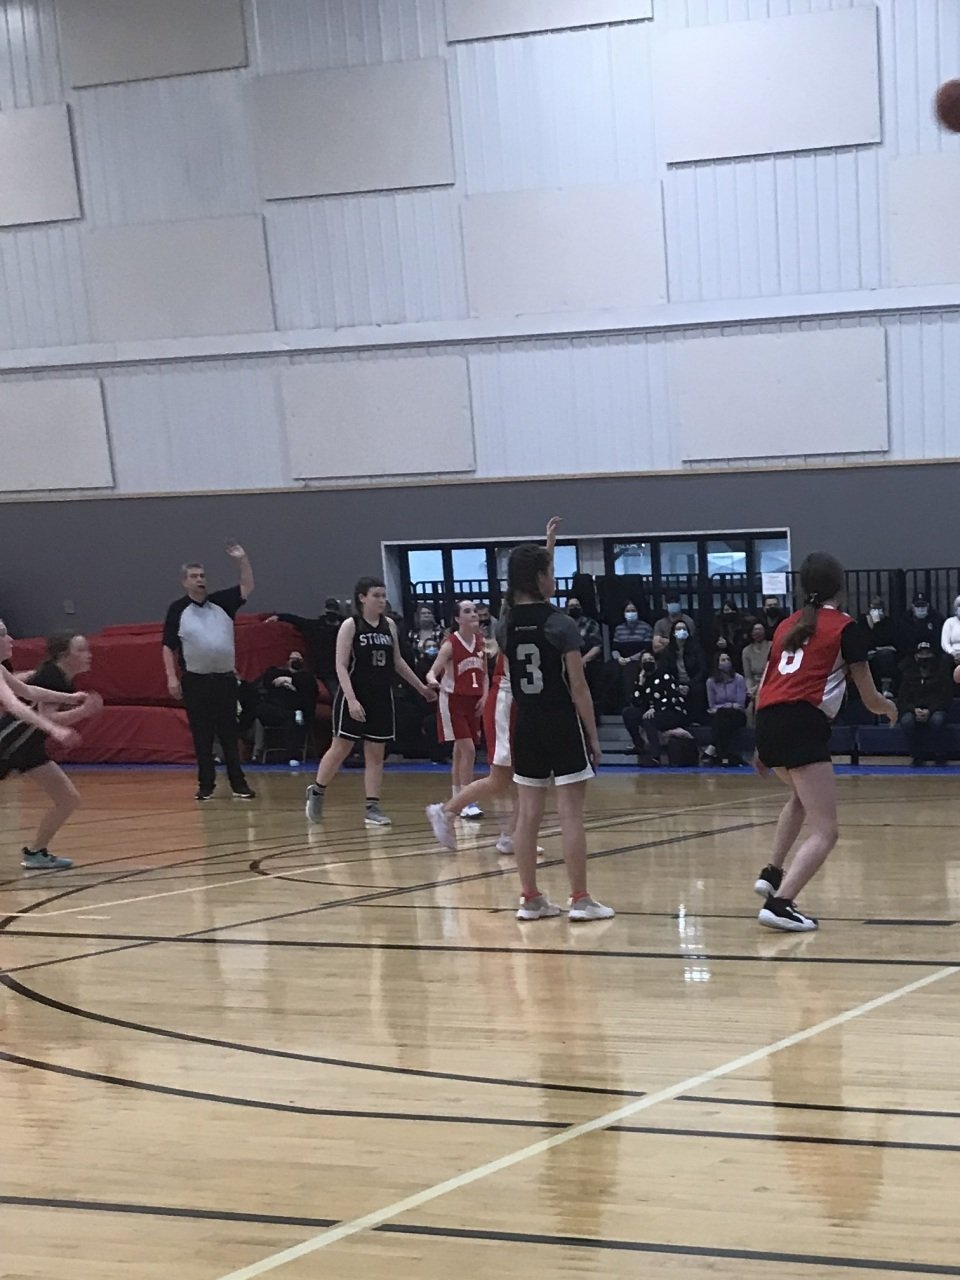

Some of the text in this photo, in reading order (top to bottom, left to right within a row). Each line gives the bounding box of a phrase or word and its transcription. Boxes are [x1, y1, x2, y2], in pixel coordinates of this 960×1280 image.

[371, 650, 387, 666] 19
[516, 643, 544, 694] 3
[471, 671, 479, 688] 1
